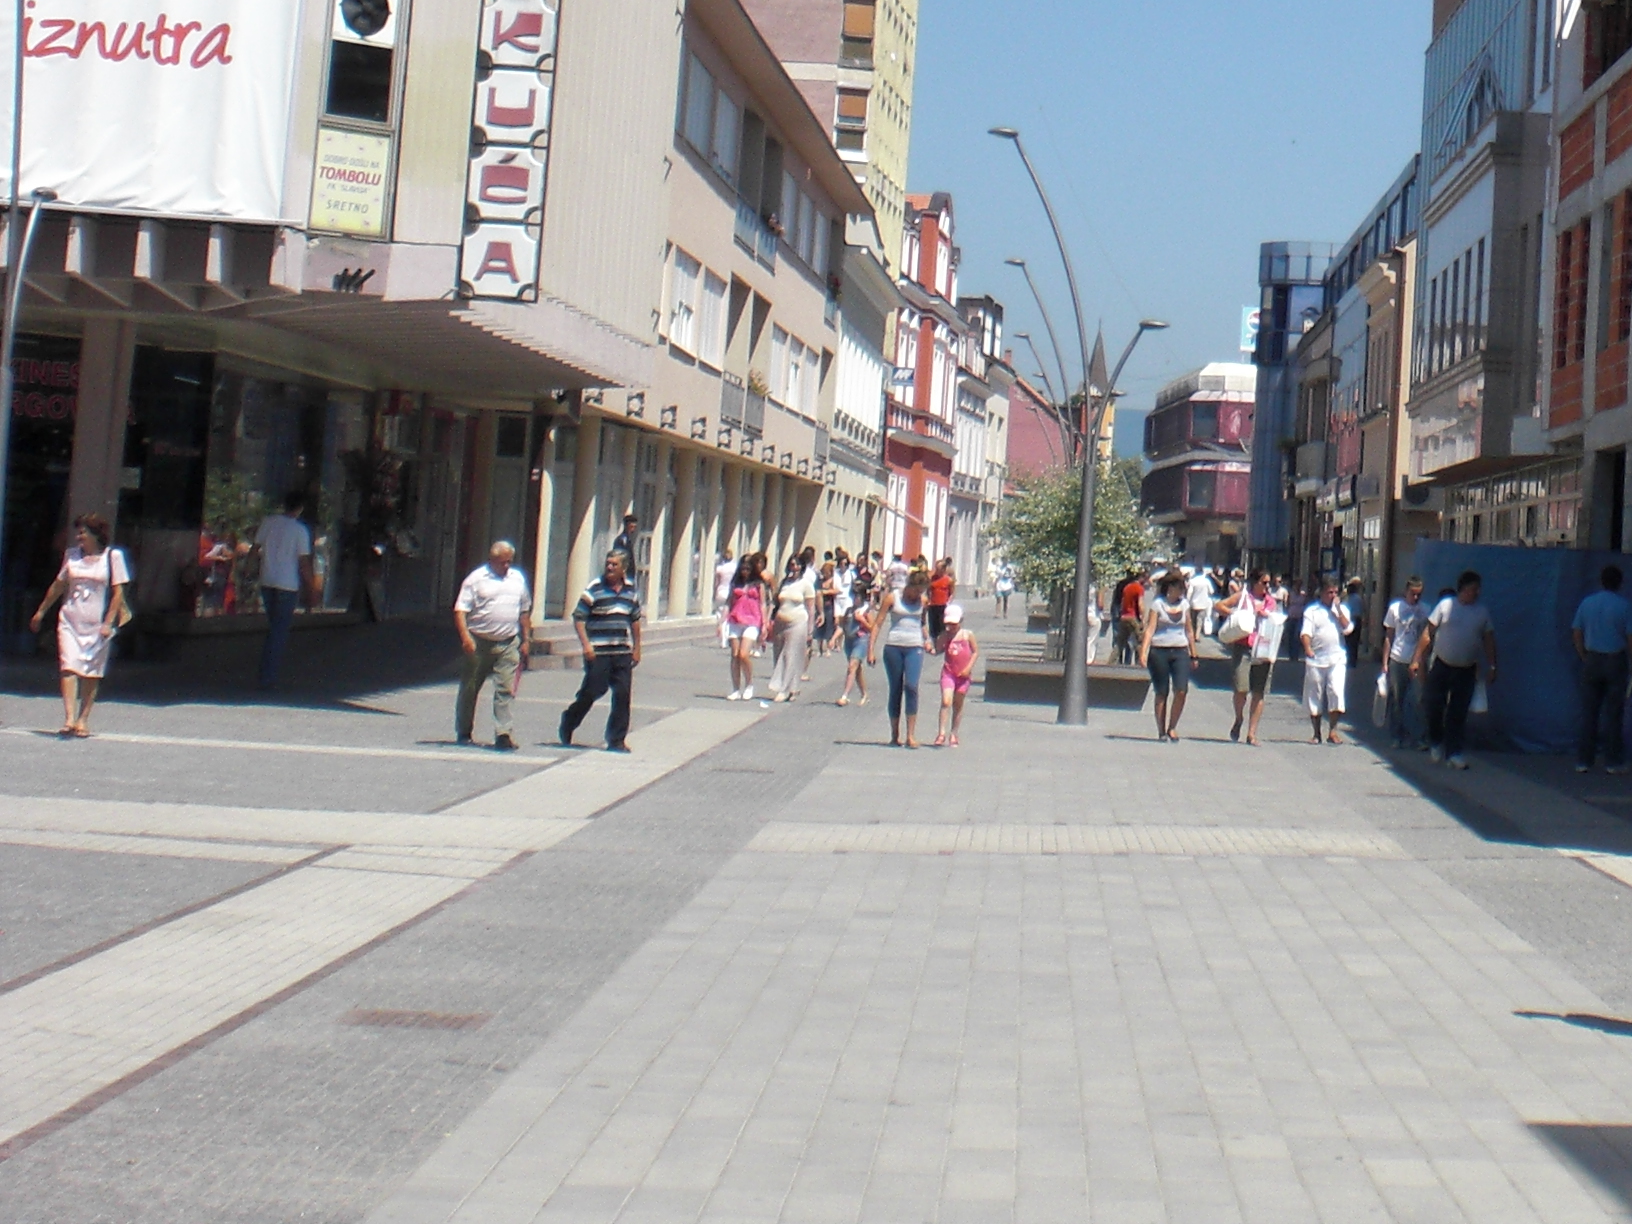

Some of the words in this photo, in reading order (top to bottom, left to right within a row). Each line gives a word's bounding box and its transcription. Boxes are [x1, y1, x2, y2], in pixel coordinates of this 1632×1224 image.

[22, 0, 233, 69] iznutra
[472, 9, 544, 284] KUĆA
[319, 166, 382, 186] TOMBOLU
[326, 199, 369, 214] SRETNO
